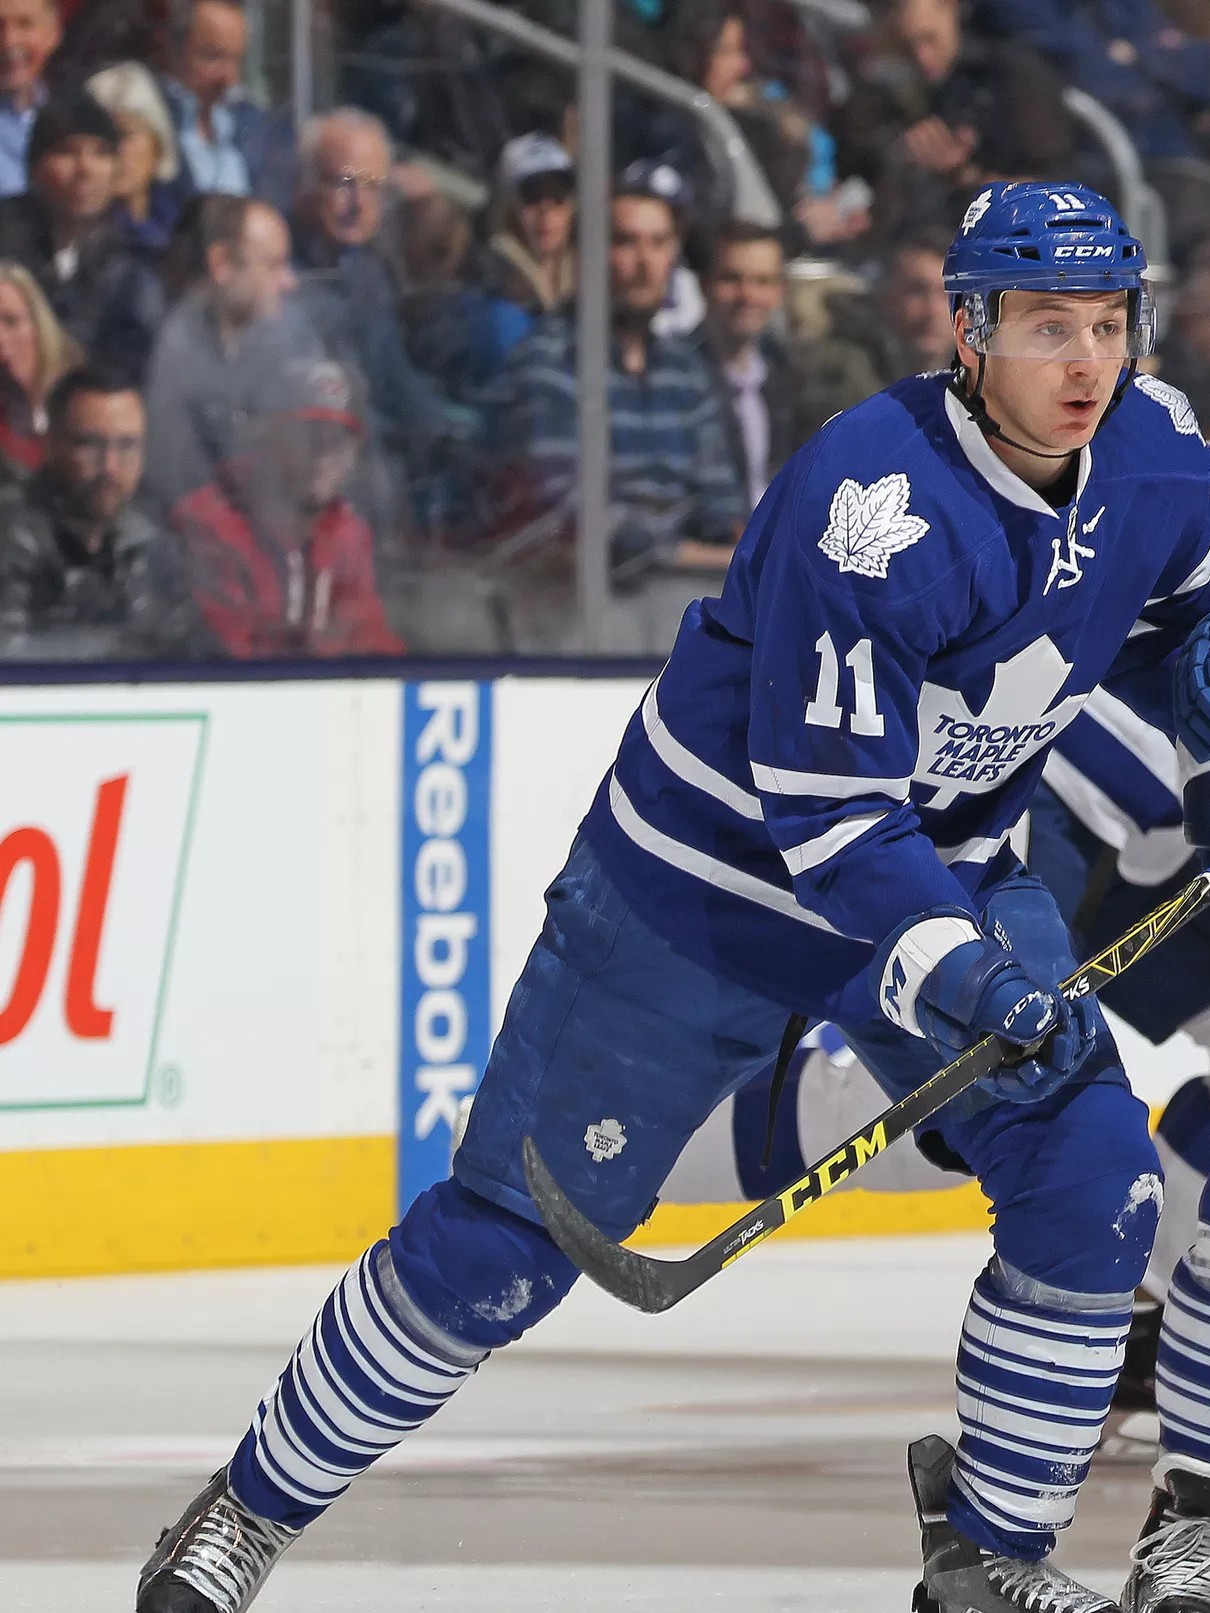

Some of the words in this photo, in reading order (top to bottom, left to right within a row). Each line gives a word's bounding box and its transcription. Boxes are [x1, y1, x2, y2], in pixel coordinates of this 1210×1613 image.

[1049, 193, 1087, 212] 11
[1054, 245, 1114, 259] CCM
[804, 630, 885, 737] 11
[933, 714, 1057, 744] TORONTO
[935, 740, 1027, 763] MAPLE
[927, 762, 1007, 783] LEAFS
[414, 680, 482, 1141] Reebok
[776, 1120, 888, 1223] CCM
